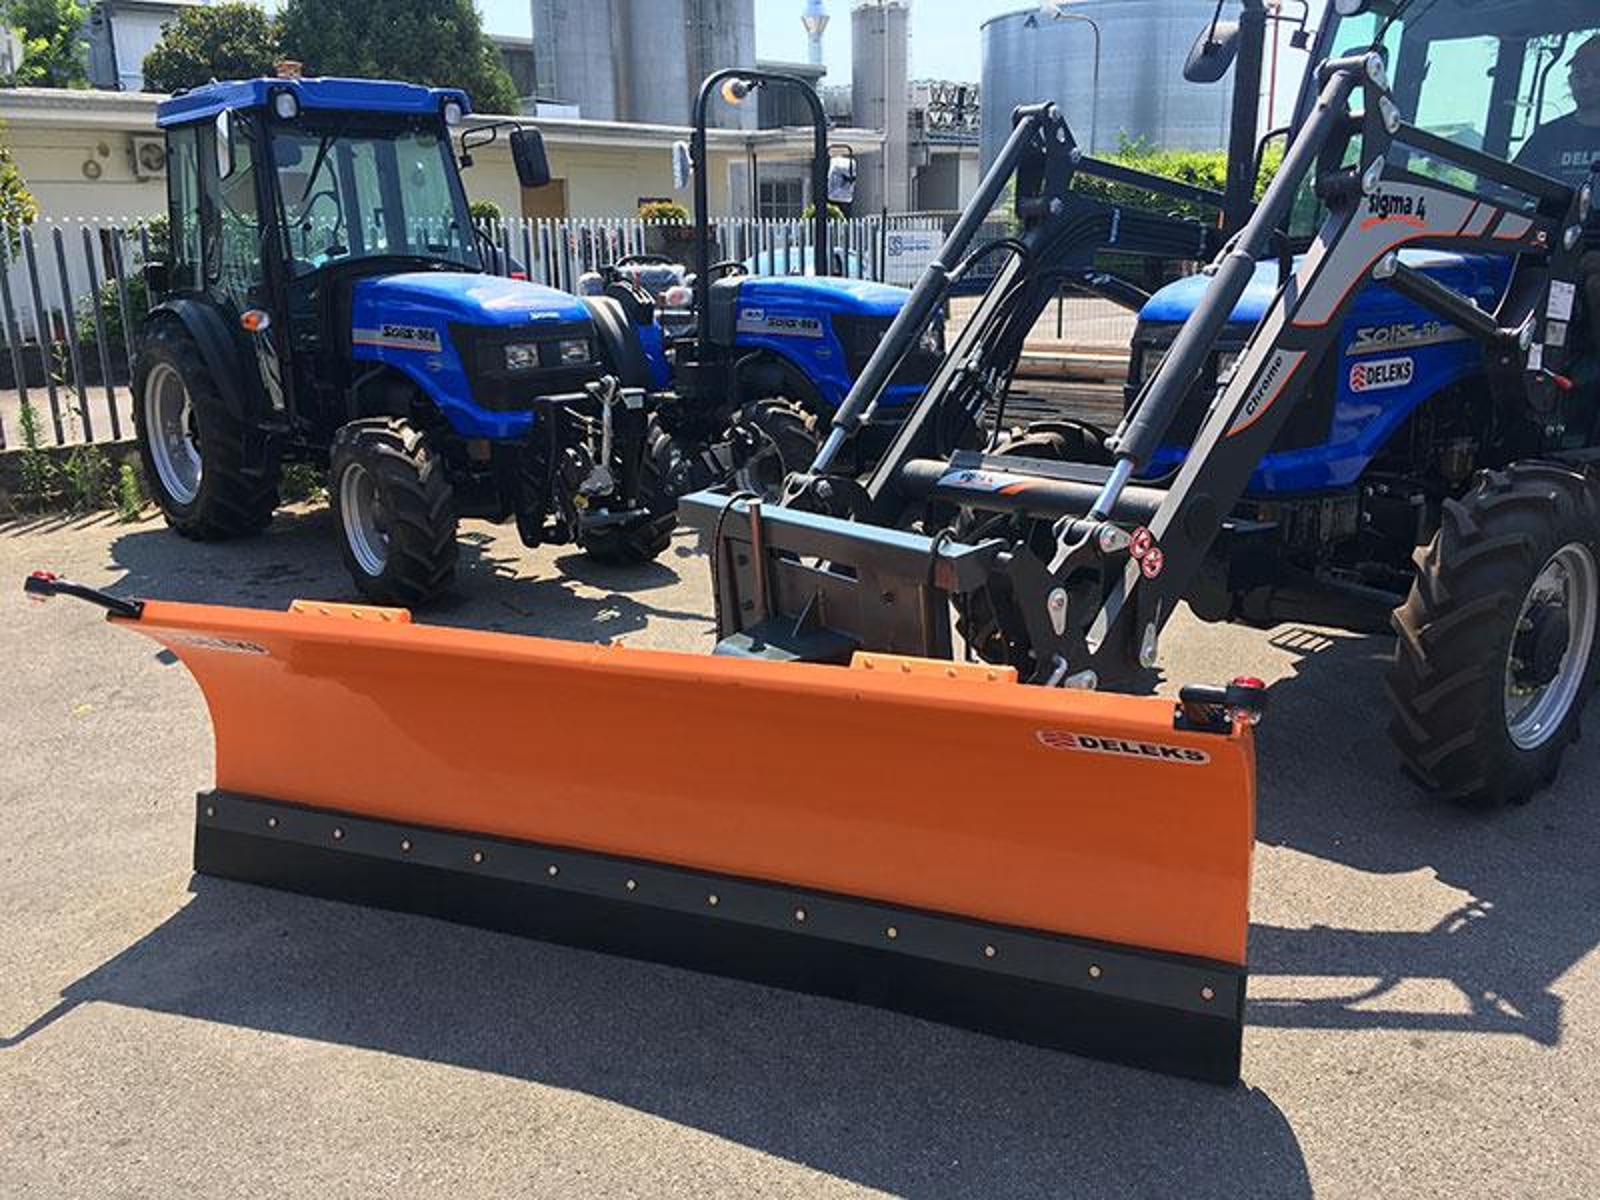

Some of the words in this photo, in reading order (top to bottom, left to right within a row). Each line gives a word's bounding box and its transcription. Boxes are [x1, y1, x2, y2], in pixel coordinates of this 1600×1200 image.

[1368, 187, 1412, 220] sigma
[1415, 195, 1425, 221] 4
[1245, 355, 1283, 416] Chrome
[1366, 360, 1411, 385] DELEKS
[1077, 735, 1205, 762] DELEKS
